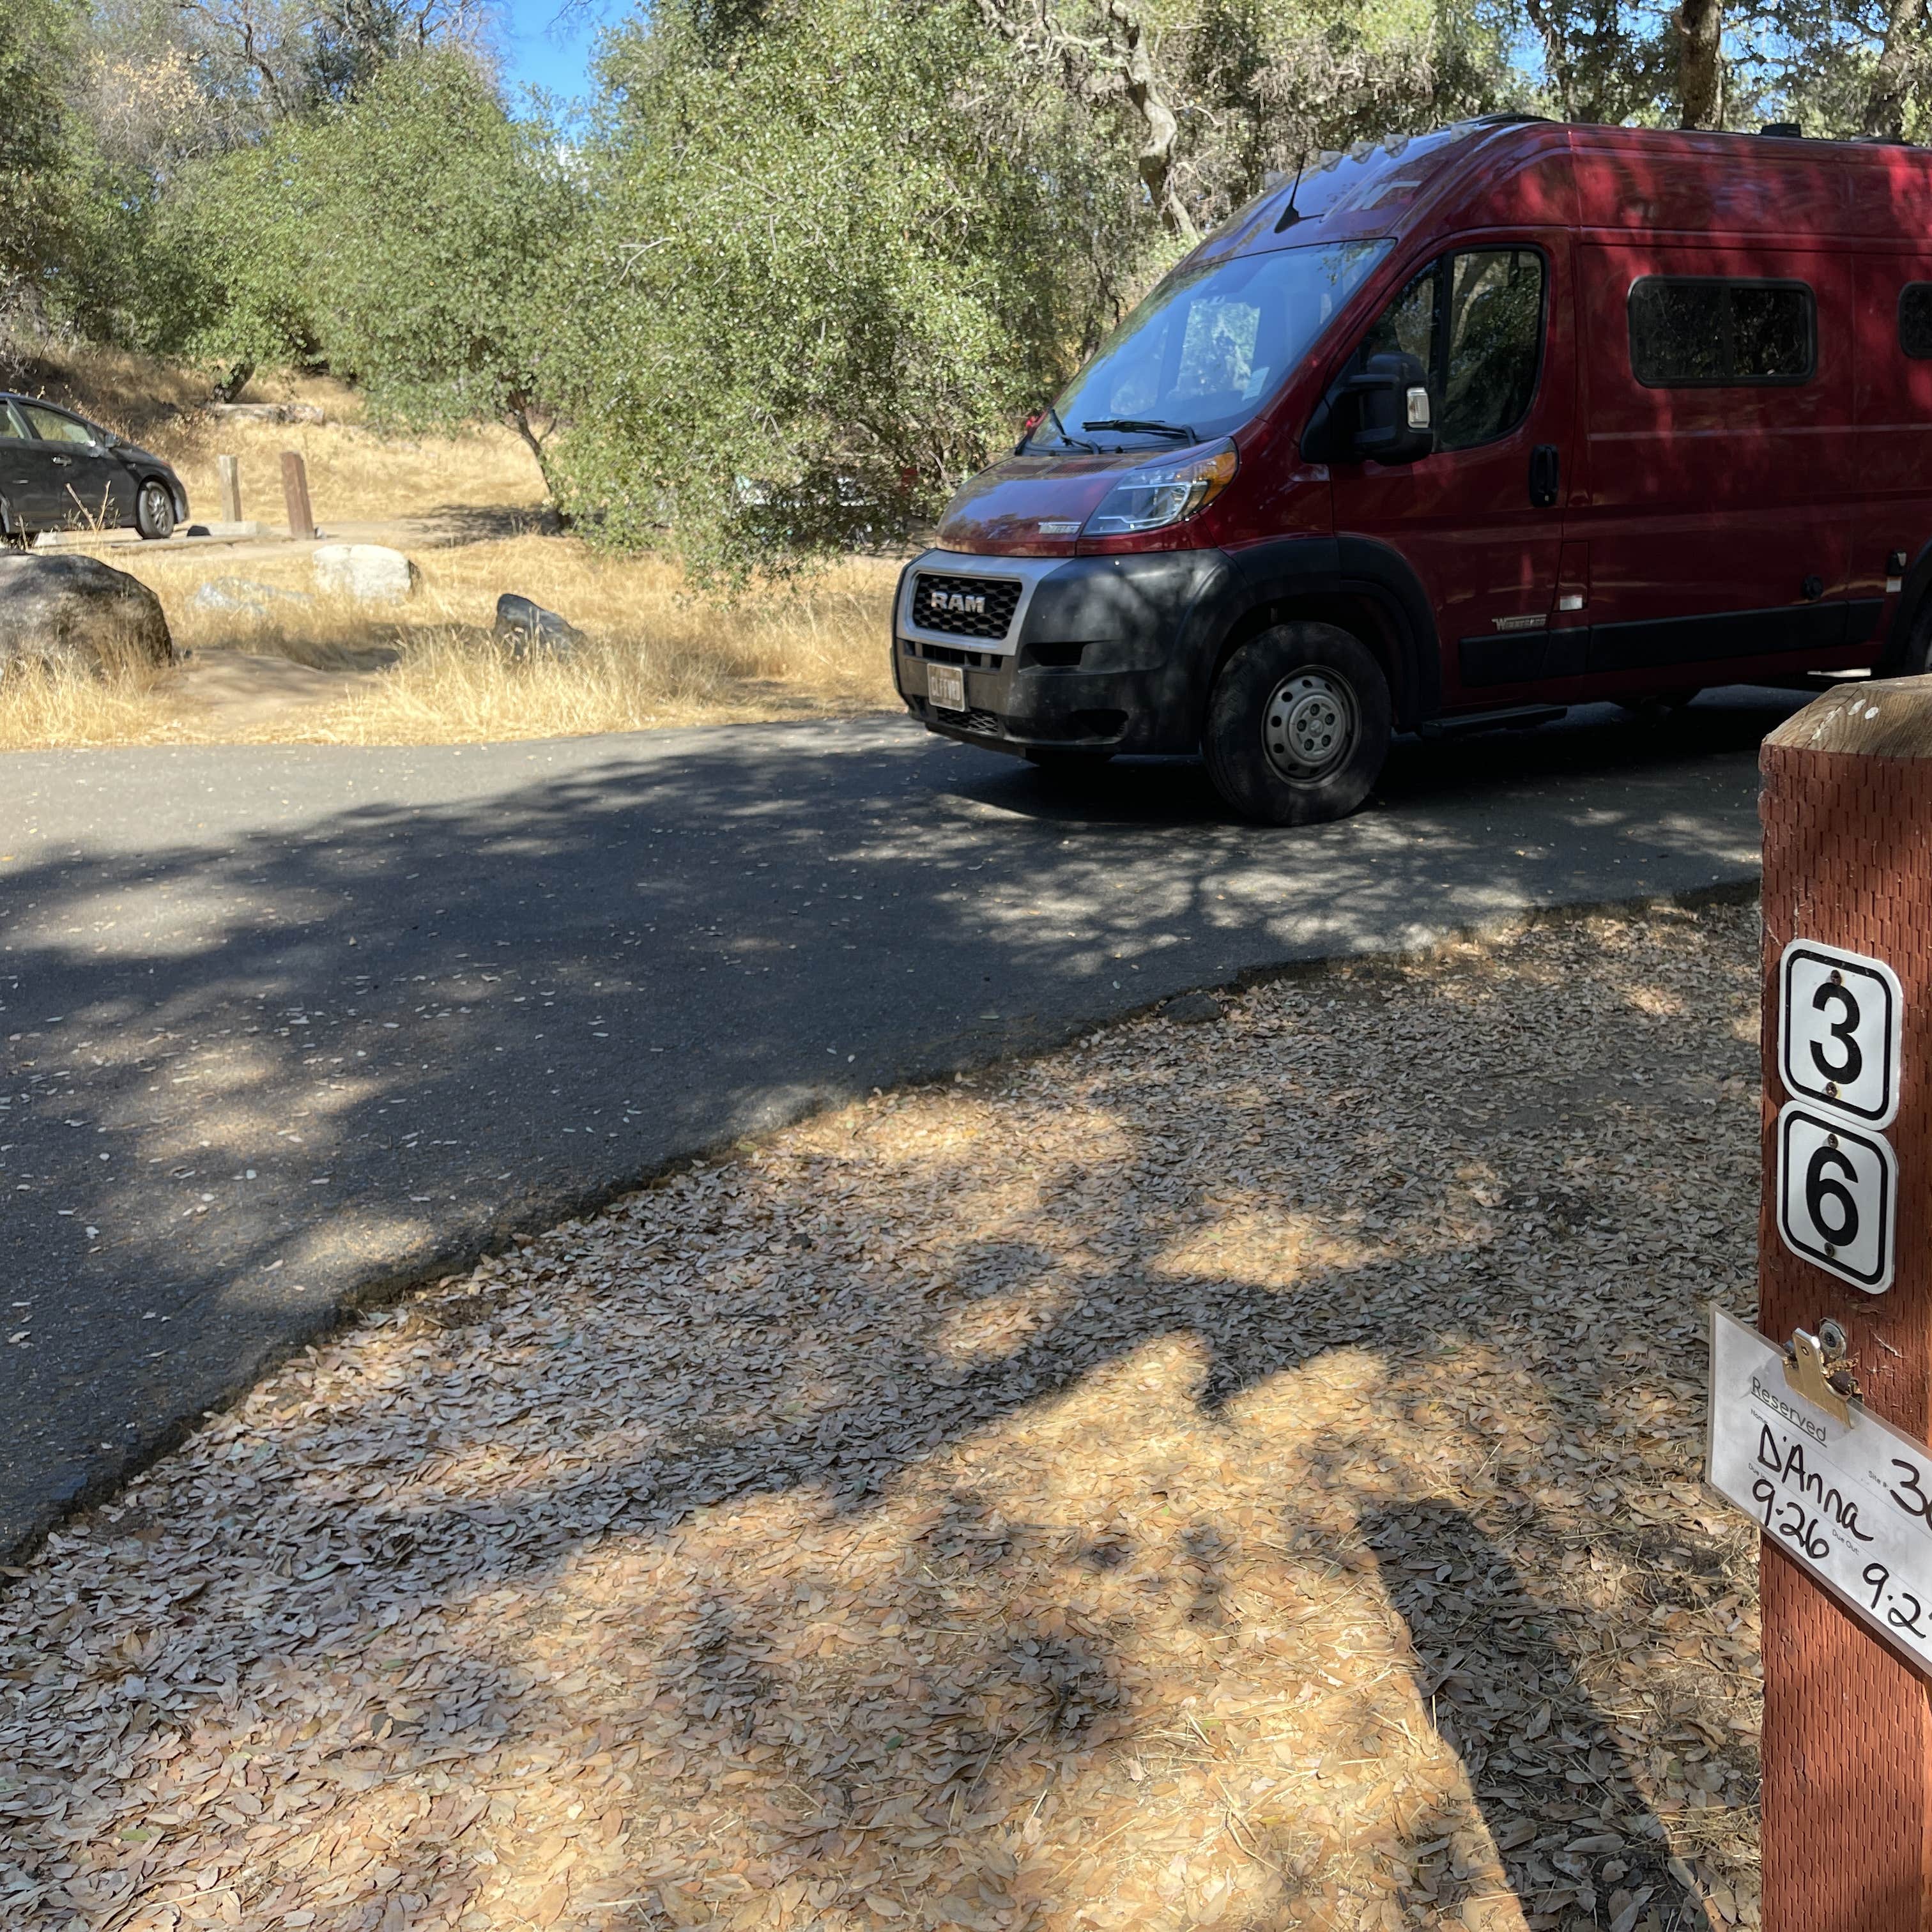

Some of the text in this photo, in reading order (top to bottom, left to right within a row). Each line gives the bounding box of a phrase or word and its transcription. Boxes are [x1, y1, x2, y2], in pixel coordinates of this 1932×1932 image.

[931, 591, 985, 613] RAM
[1809, 982, 1862, 1085] 3
[1806, 1146, 1859, 1246] 6
[1752, 1376, 1827, 1443] Reserved
[1832, 1529, 1845, 1544] Due
